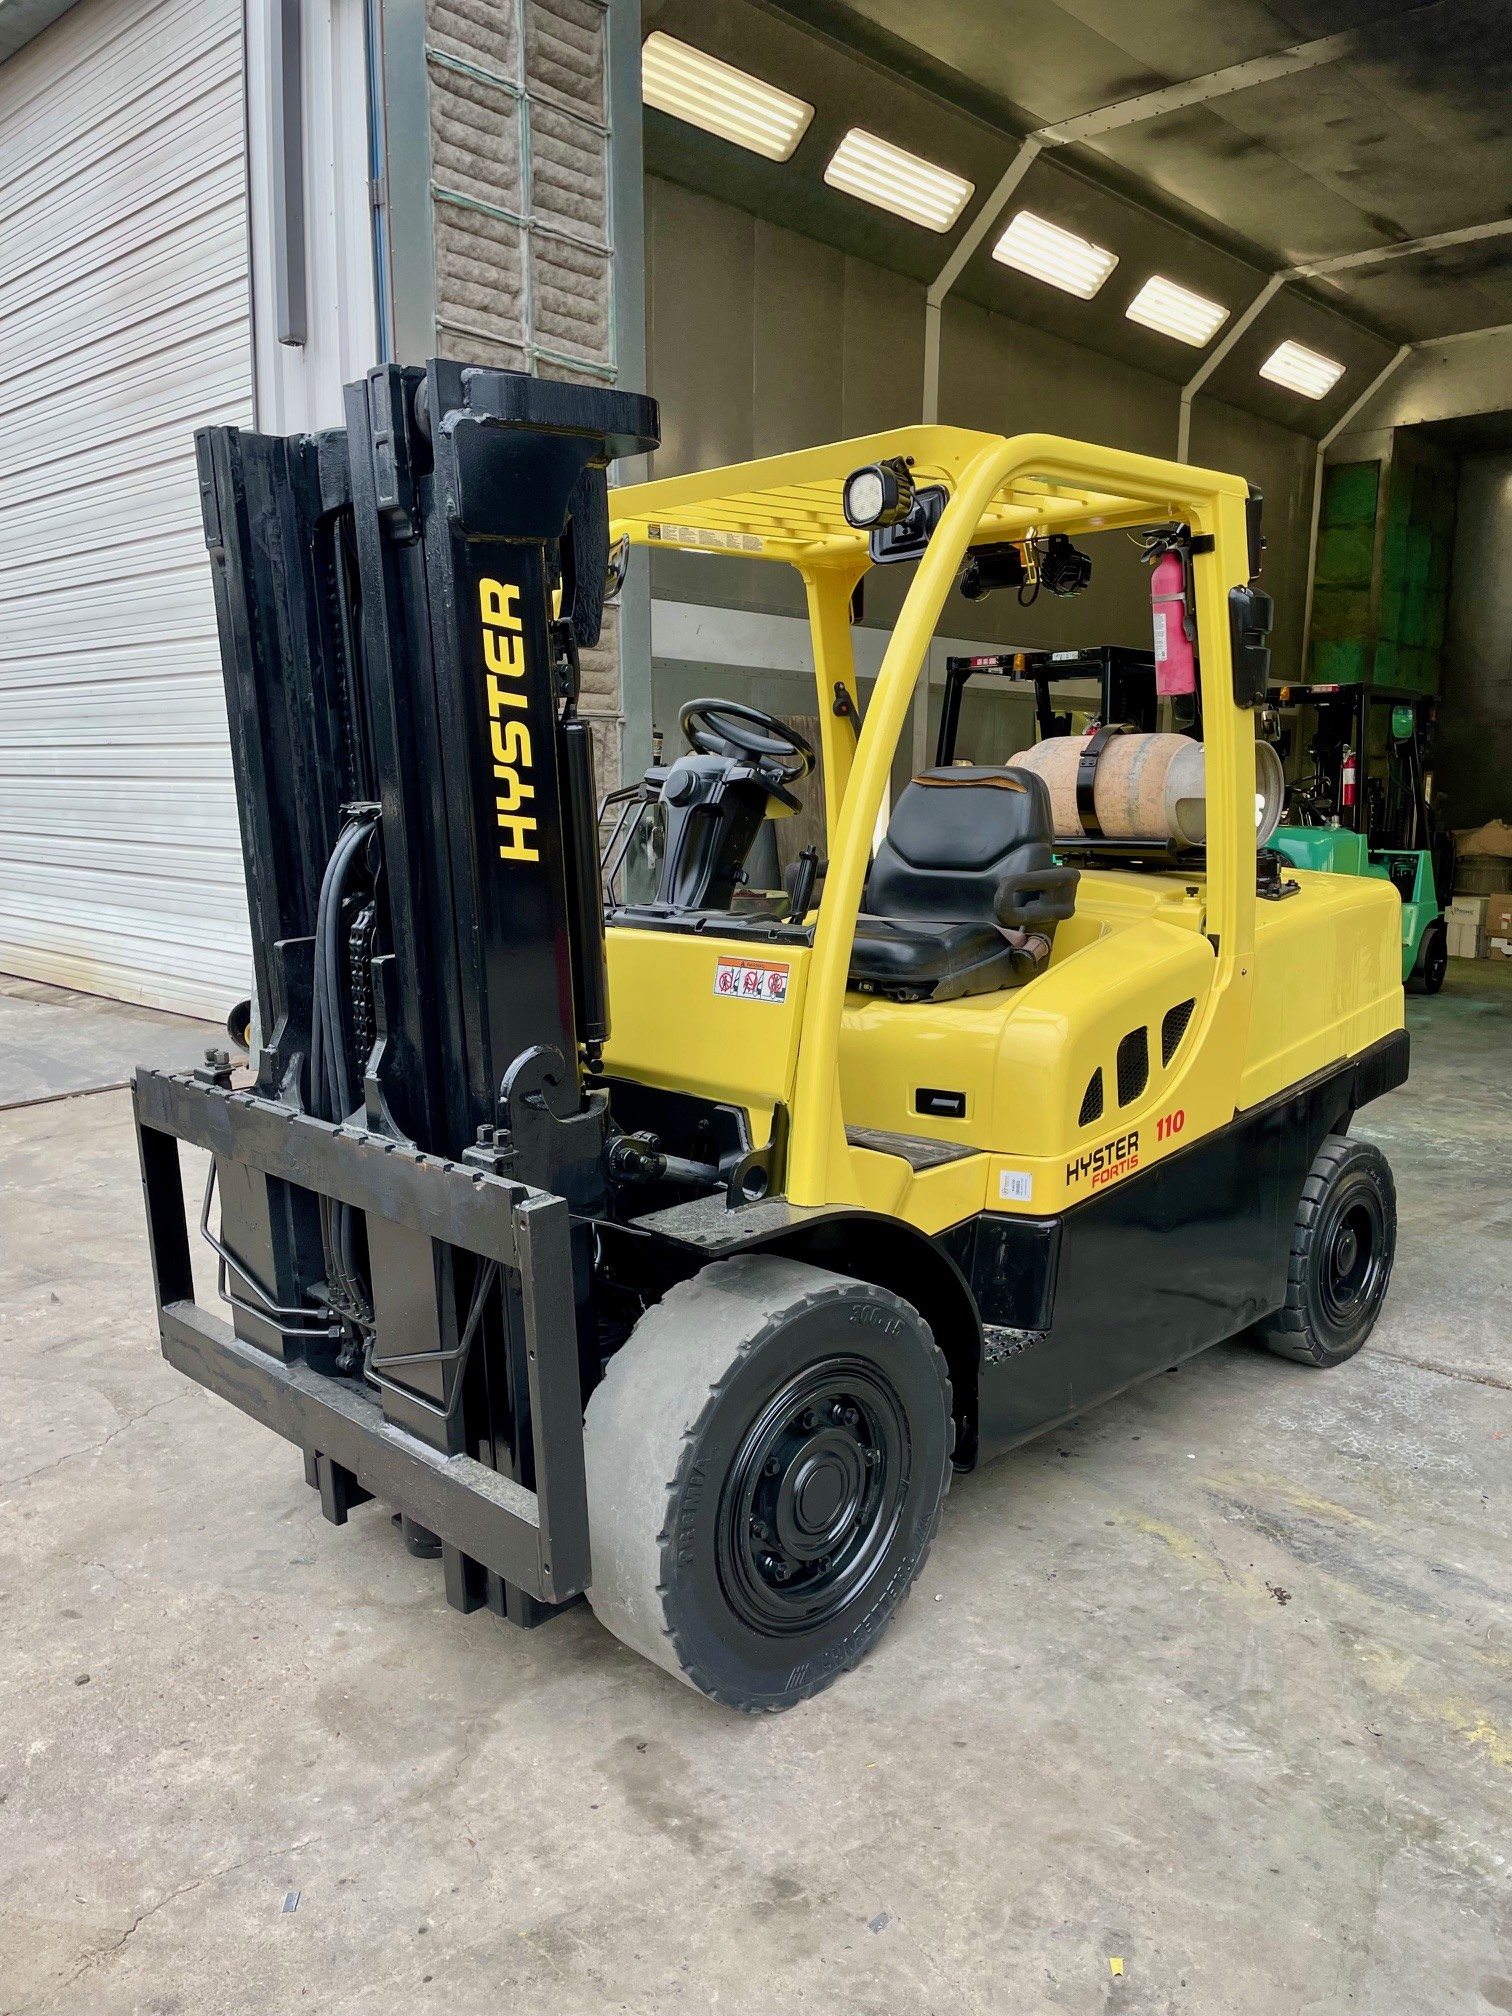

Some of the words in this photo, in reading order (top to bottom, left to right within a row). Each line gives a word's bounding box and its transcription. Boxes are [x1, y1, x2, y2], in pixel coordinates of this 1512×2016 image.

[479, 577, 540, 862] HYSTER
[1066, 1130, 1139, 1186] HYSTER
[1156, 1109, 1185, 1142] 110
[1092, 1154, 1139, 1188] FORTIS
